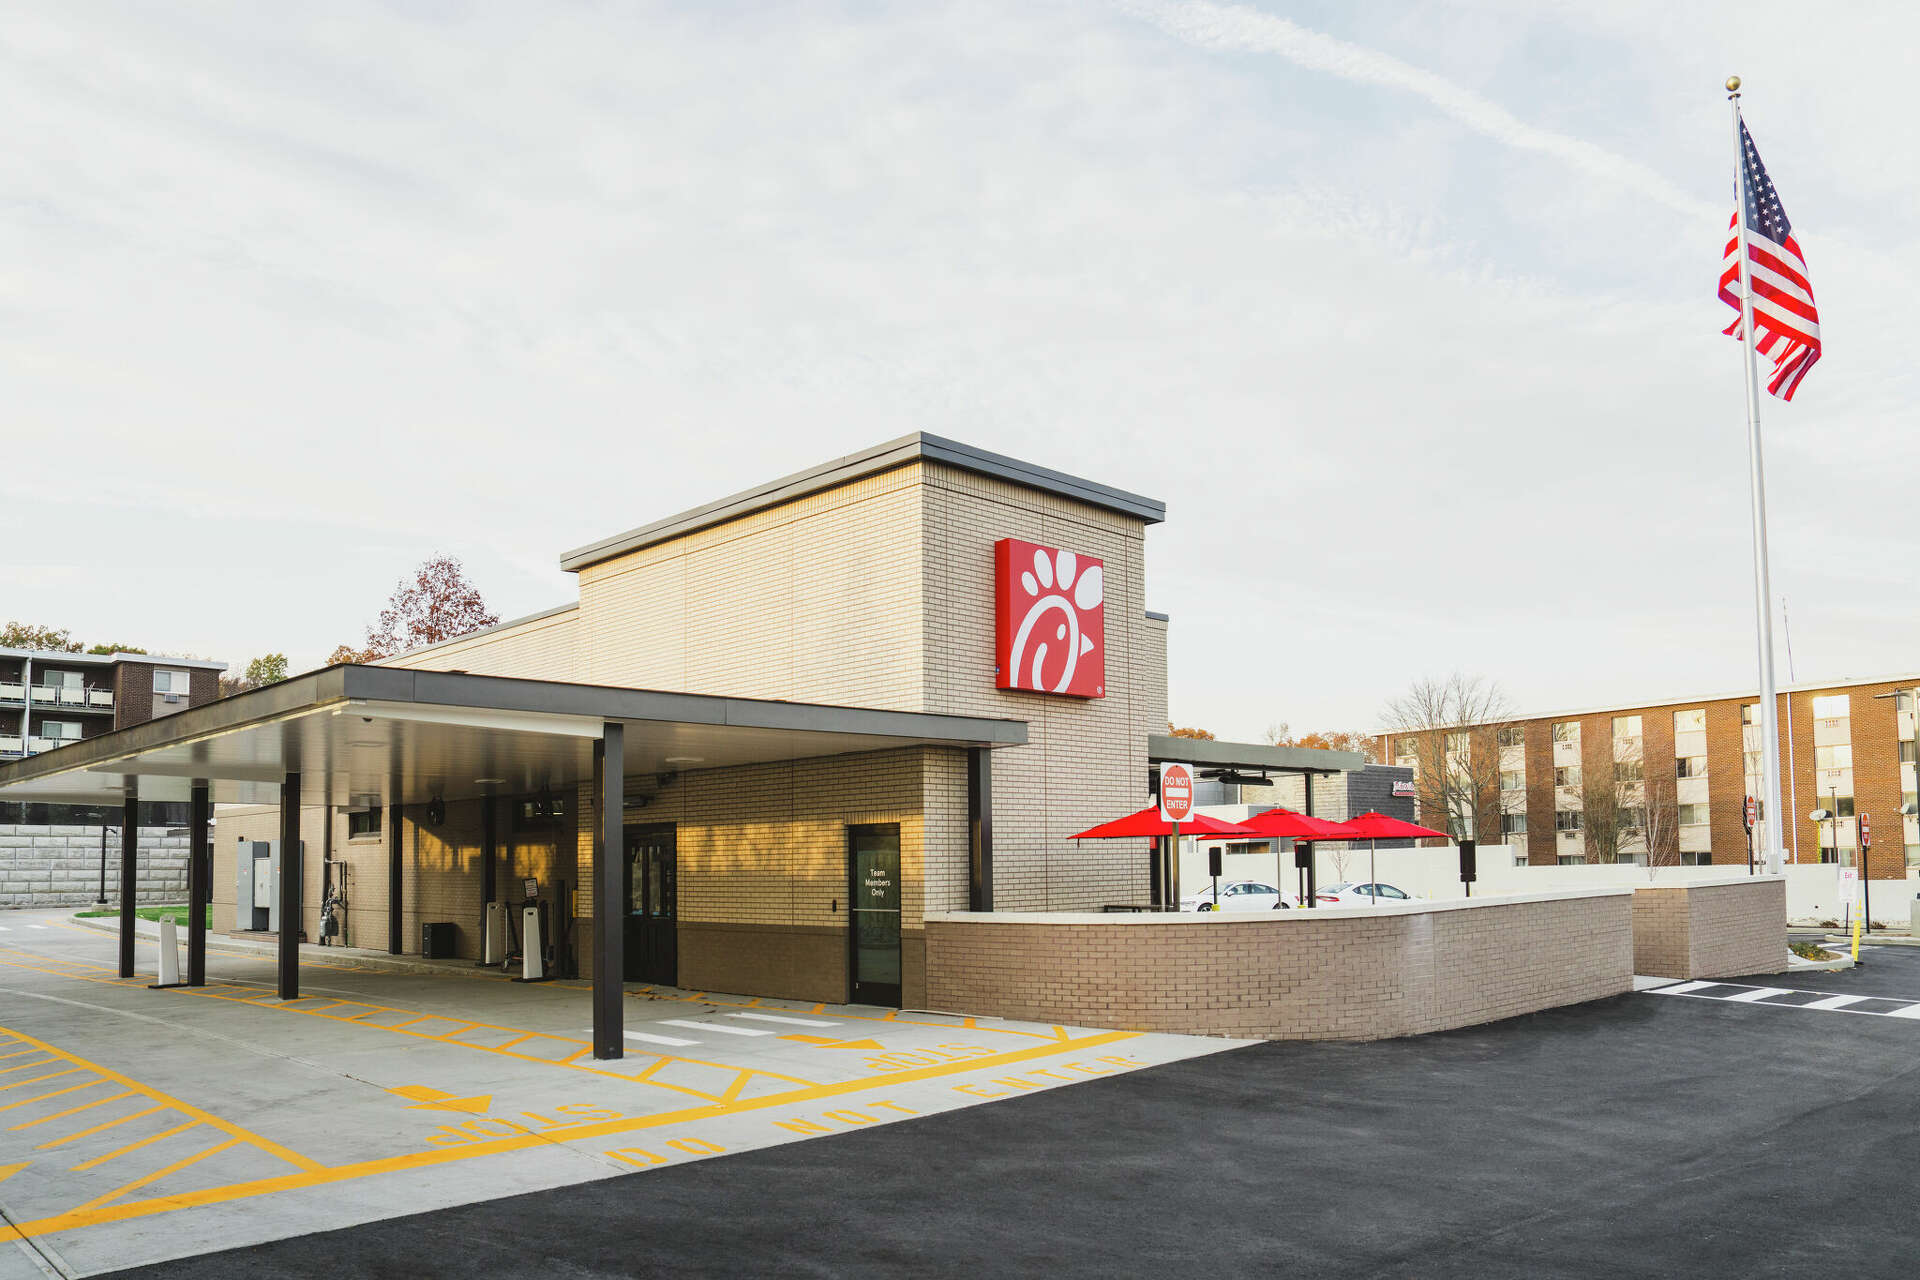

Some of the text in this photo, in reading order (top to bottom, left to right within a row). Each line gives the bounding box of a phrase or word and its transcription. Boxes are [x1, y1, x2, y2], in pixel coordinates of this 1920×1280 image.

[1165, 776, 1189, 786] DO NOT
[1166, 799, 1188, 809] ENTER
[870, 869, 885, 877] Team
[865, 878, 891, 887] Members
[871, 888, 885, 898] Only
[864, 1042, 997, 1071] STOP
[602, 1056, 1149, 1168] DO NOT ENTER
[424, 1103, 624, 1146] STOP
